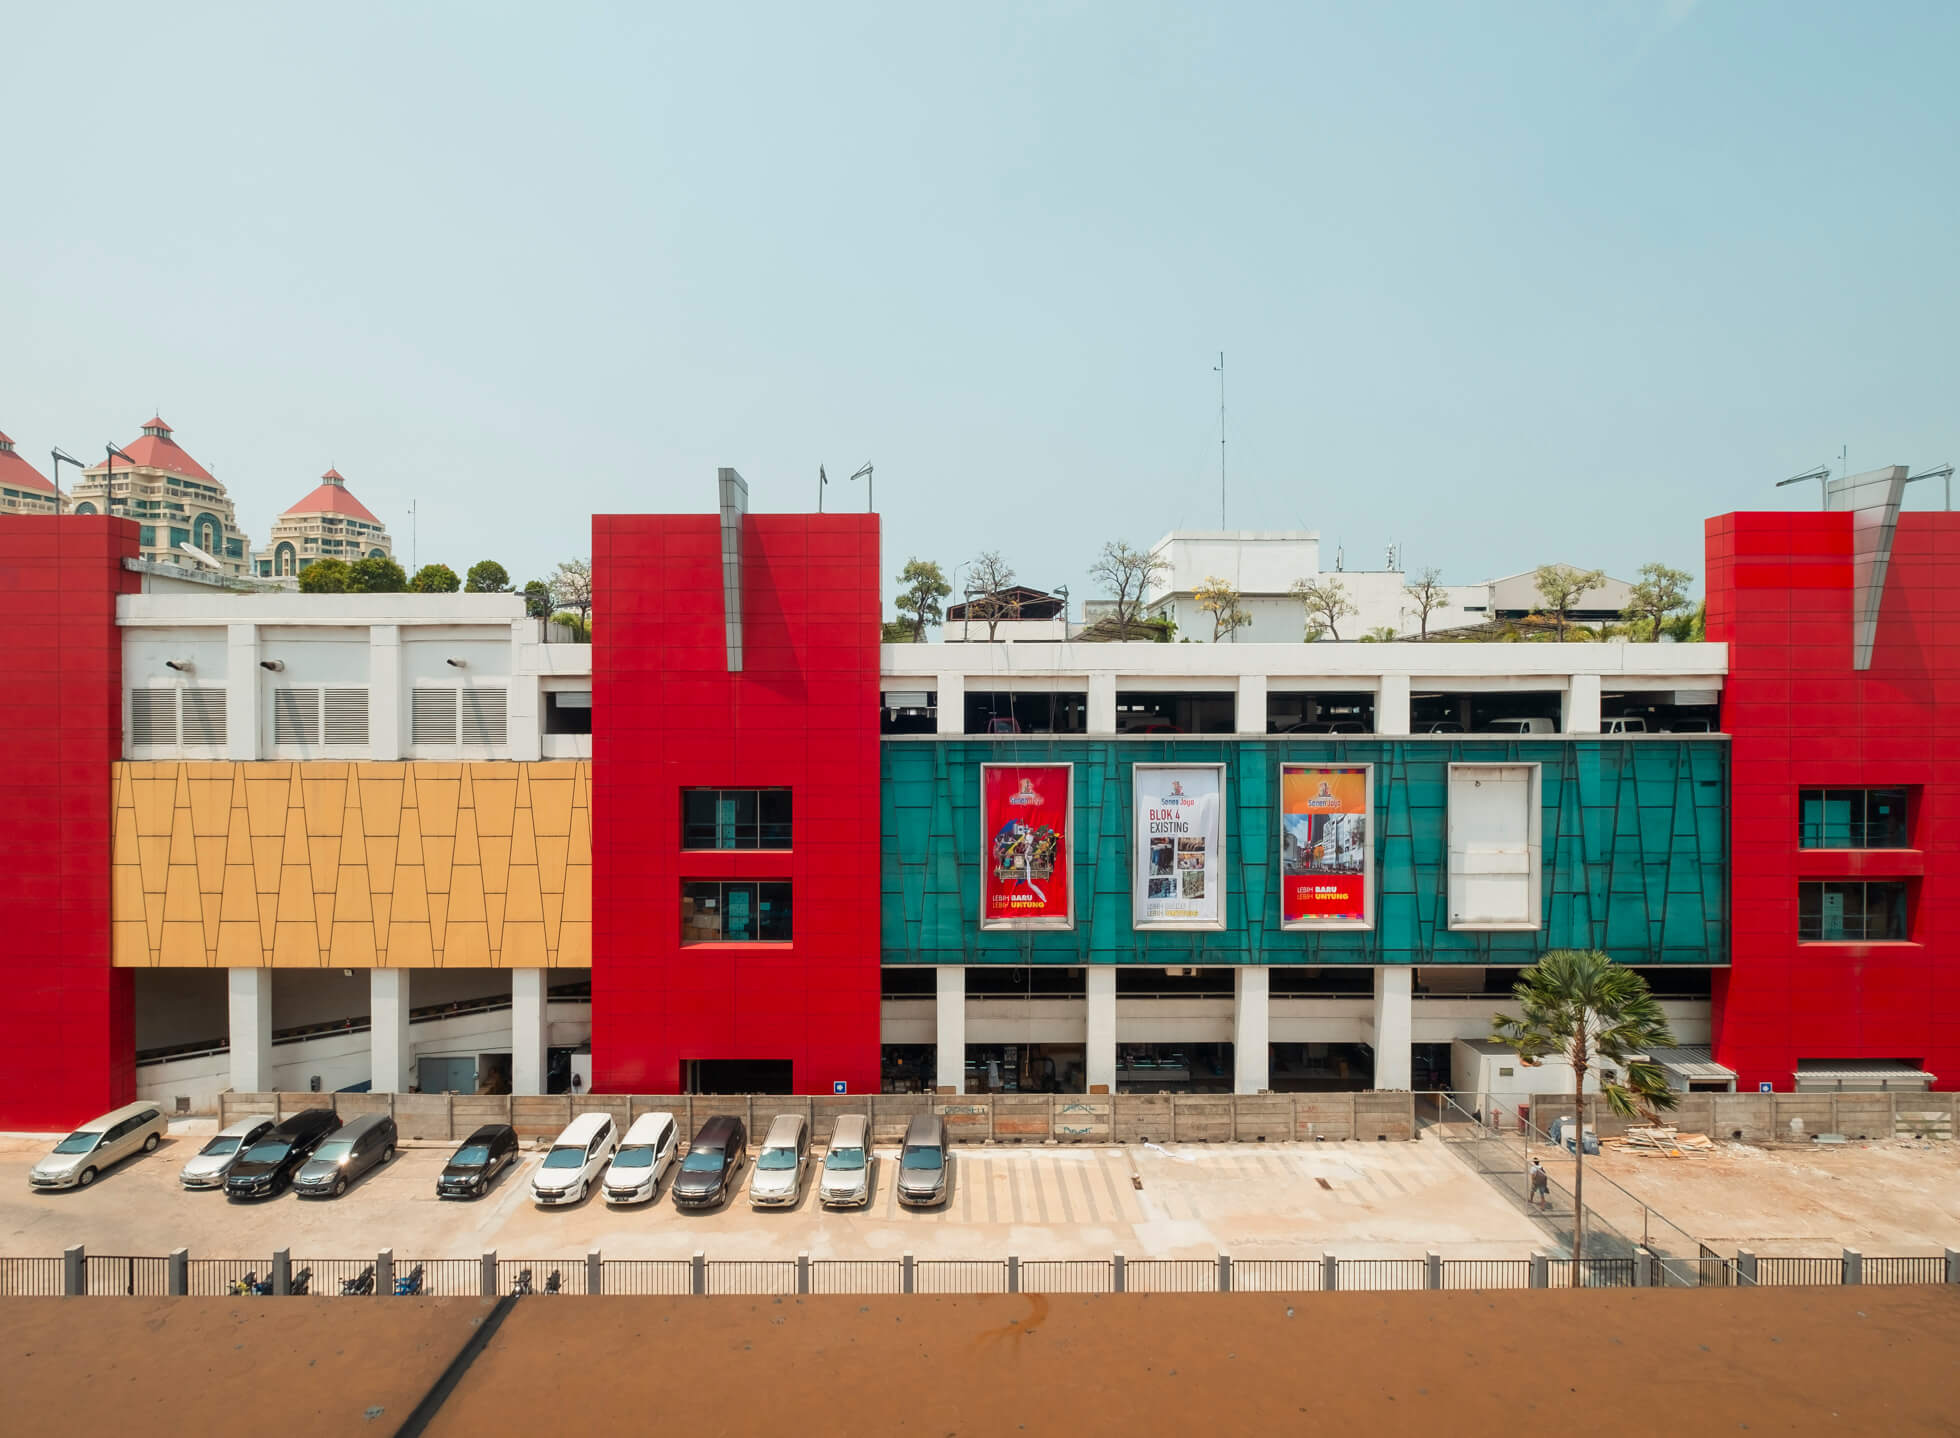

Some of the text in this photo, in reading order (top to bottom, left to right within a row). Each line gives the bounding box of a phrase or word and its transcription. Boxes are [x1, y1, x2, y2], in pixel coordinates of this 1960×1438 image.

[1149, 809, 1181, 821] BLOK 4
[1150, 822, 1189, 834] EXISTING
